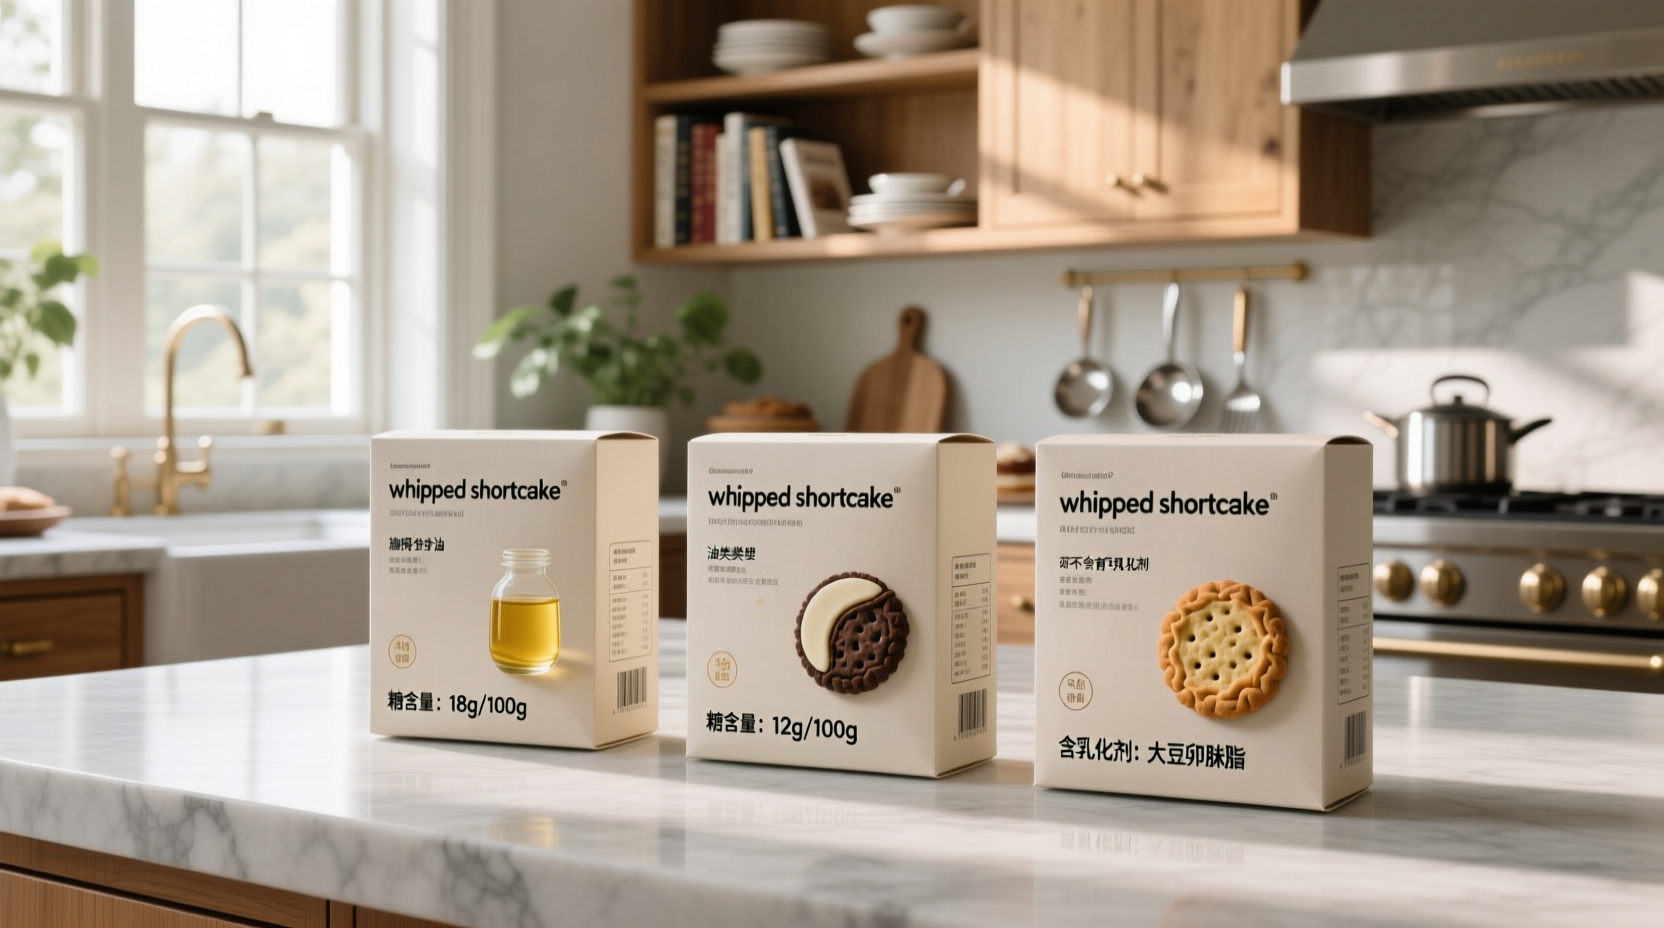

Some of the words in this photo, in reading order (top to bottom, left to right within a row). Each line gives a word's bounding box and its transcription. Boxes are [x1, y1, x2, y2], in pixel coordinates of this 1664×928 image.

[389, 478, 467, 504] whipped
[708, 484, 791, 513] whipped
[1059, 490, 1154, 519] whipped
